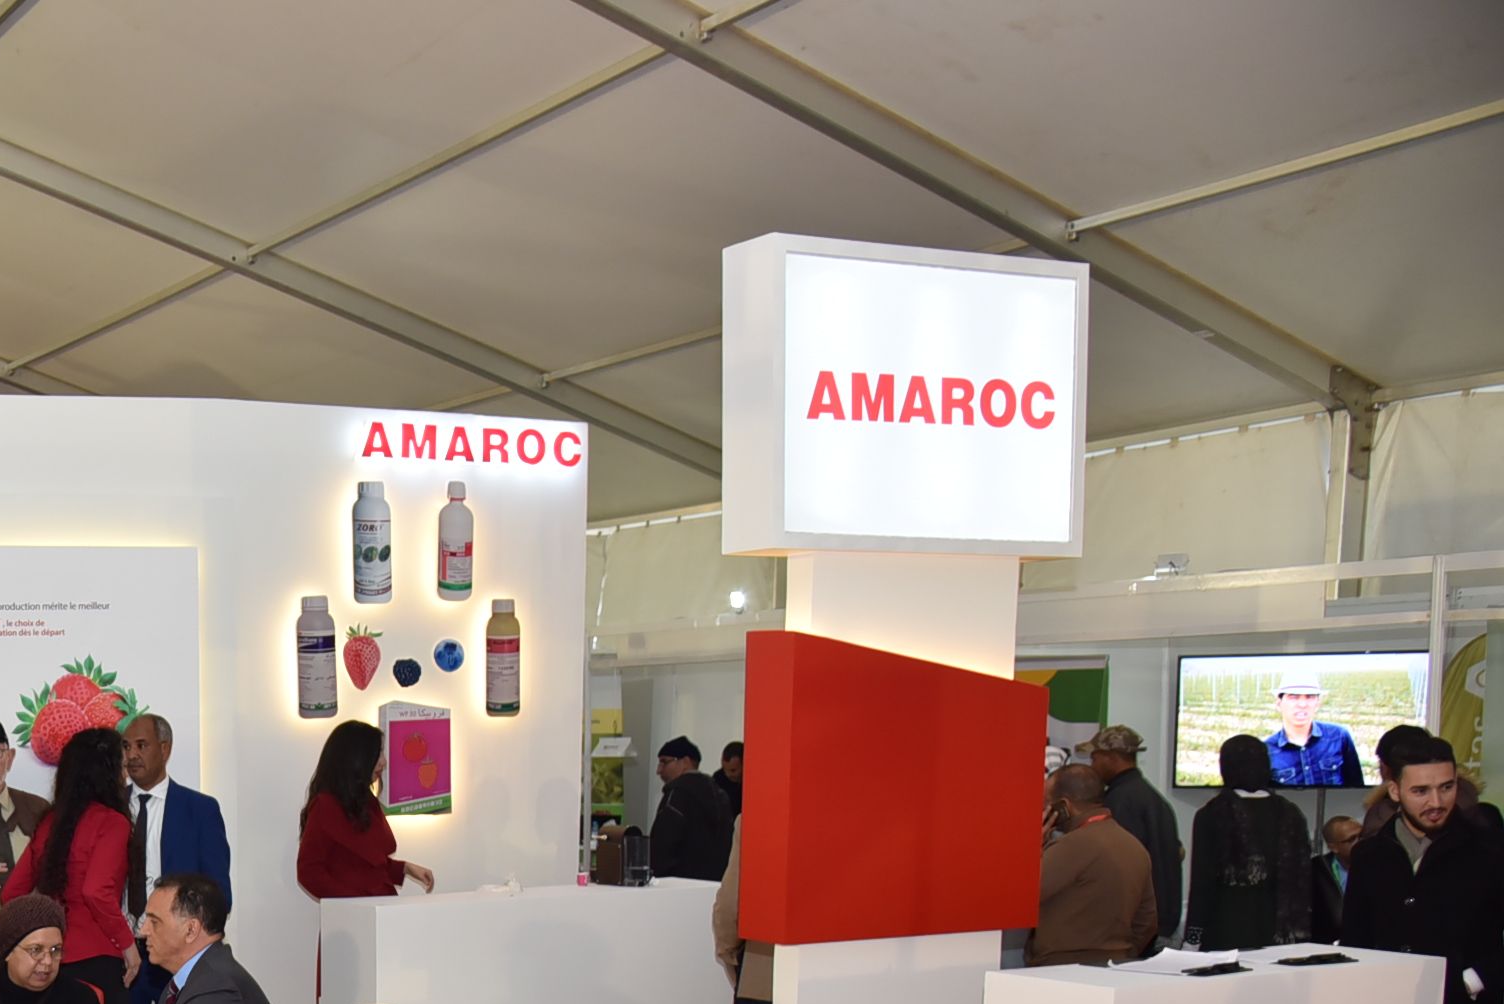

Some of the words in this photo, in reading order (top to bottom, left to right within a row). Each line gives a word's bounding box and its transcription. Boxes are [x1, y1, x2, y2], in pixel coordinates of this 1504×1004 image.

[805, 370, 1056, 430] AMAROC
[361, 421, 582, 468] AMAROC
[42, 601, 68, 611] mérite
[69, 601, 76, 610] le
[78, 601, 110, 610] meilleur
[6, 619, 13, 627] le
[14, 619, 34, 627] choix
[35, 619, 45, 627] de
[32, 629, 39, 637] le
[41, 628, 65, 638] départ
